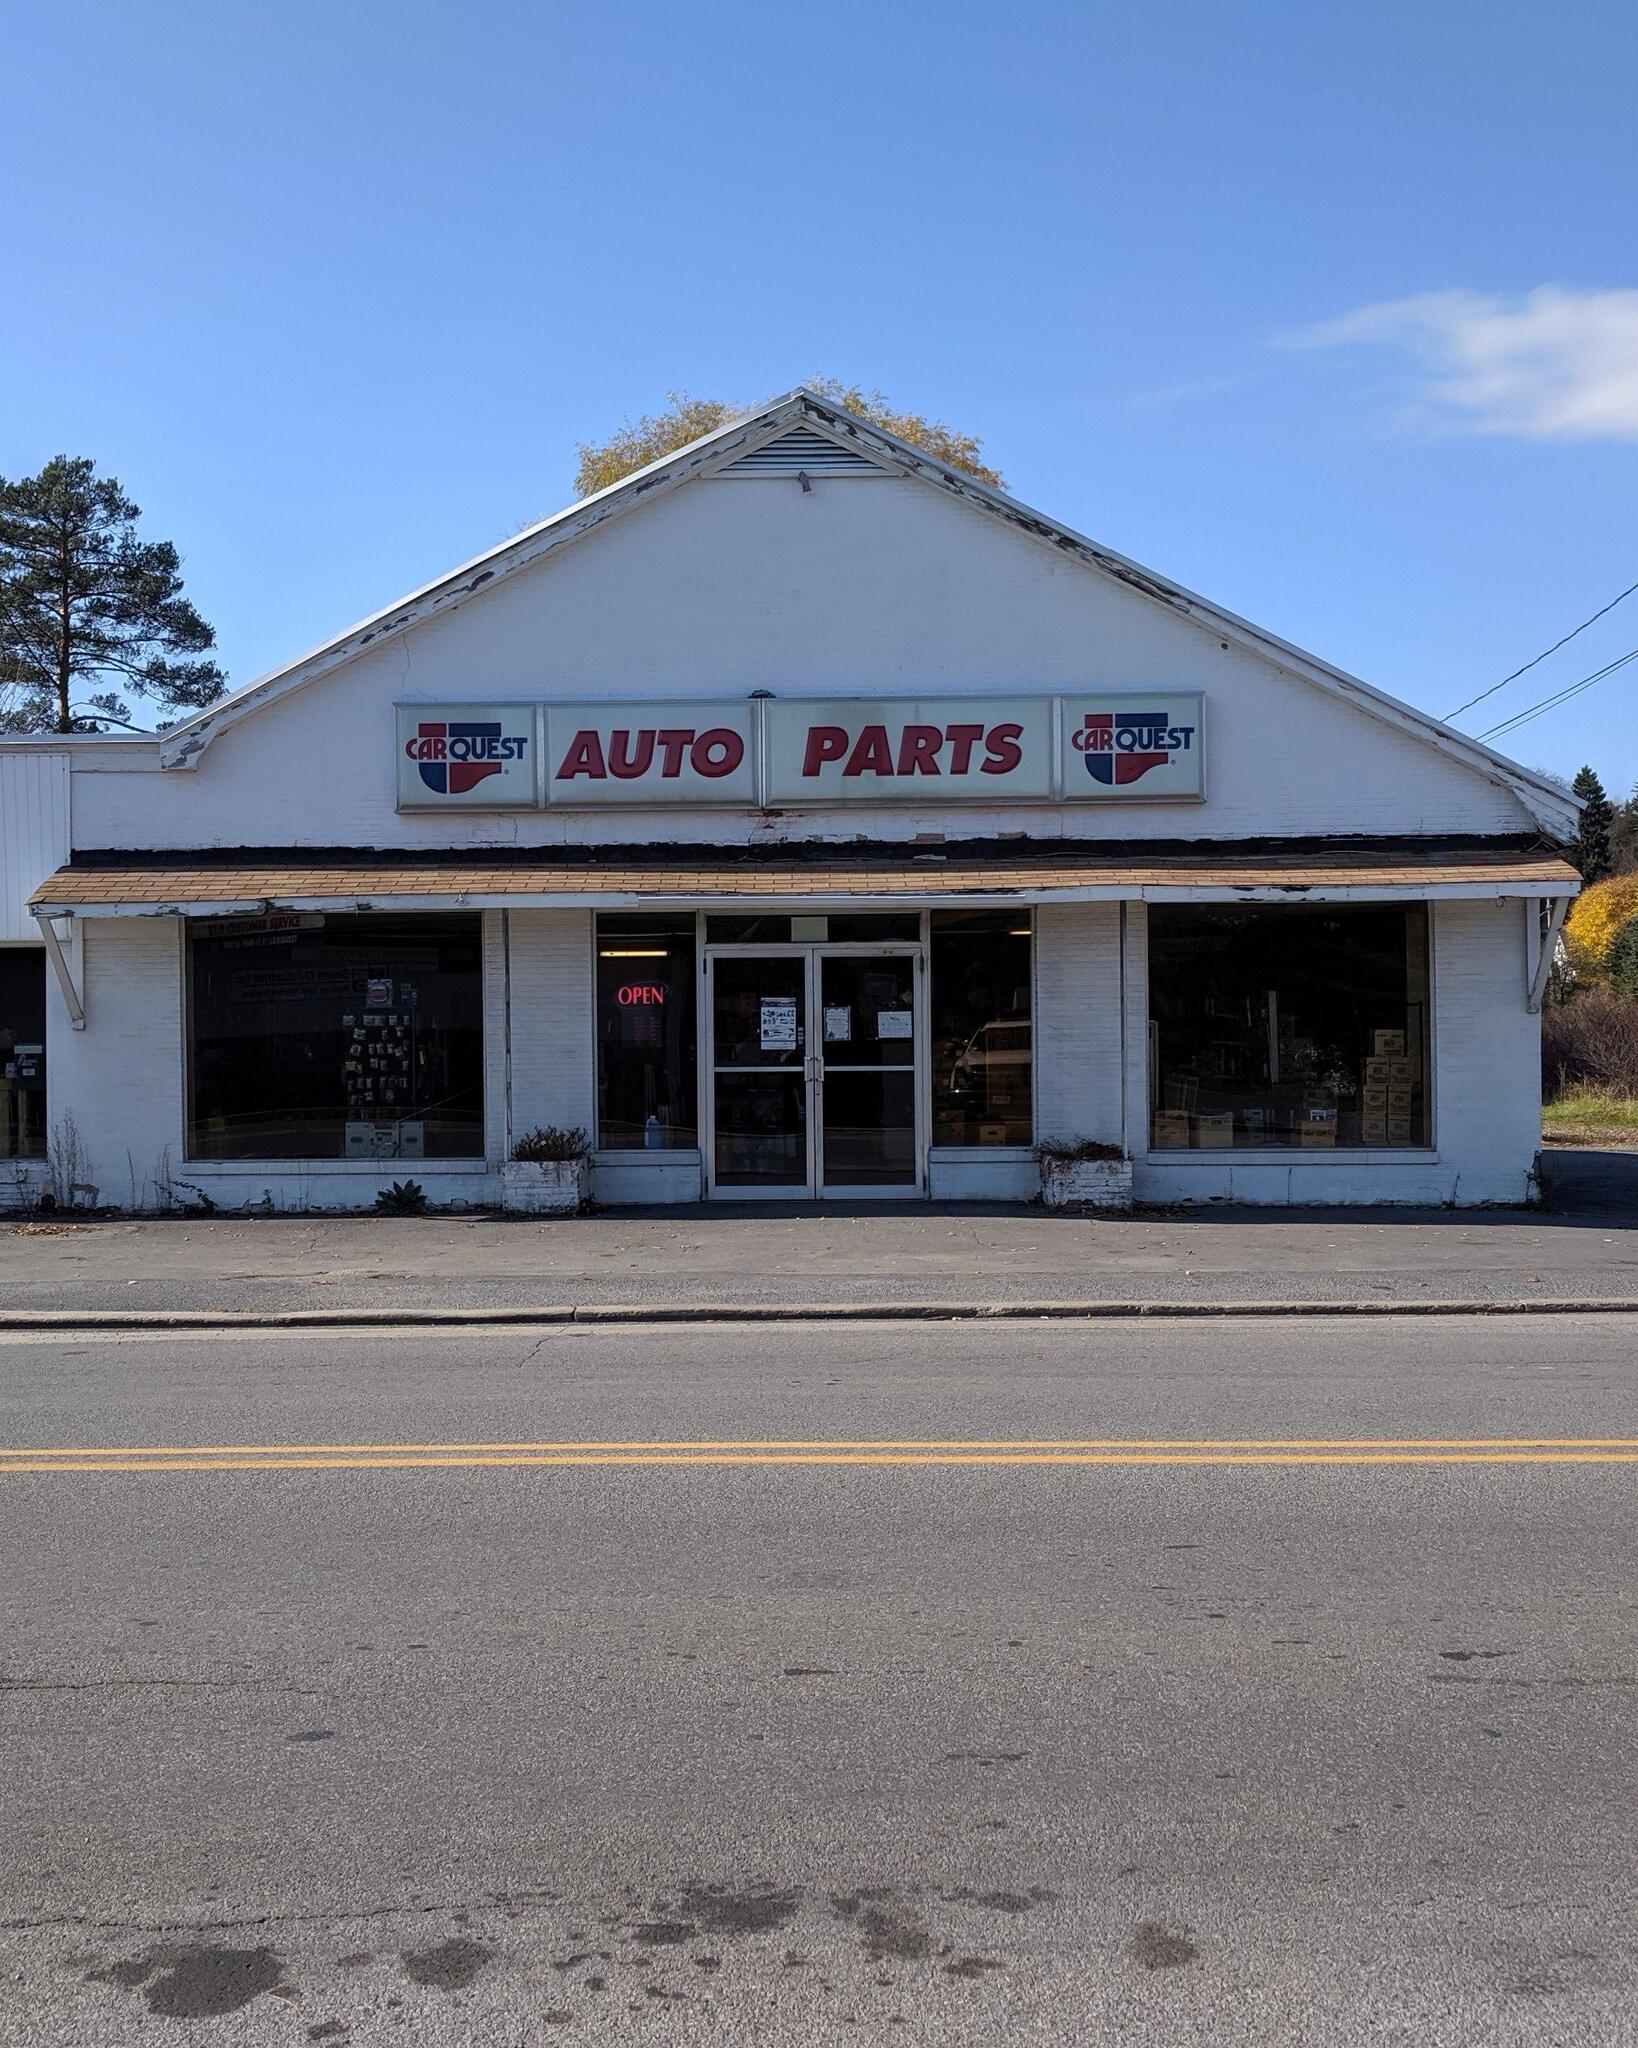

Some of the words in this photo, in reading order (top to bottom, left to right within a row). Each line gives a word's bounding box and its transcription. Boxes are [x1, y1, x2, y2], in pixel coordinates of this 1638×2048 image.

[405, 736, 528, 761] CARQUEST
[555, 728, 745, 780] AUTO
[802, 723, 1025, 777] PARTS
[1071, 727, 1195, 752] CARQUEST
[270, 915, 302, 929] SERVICE
[618, 986, 664, 1005] OPEN
